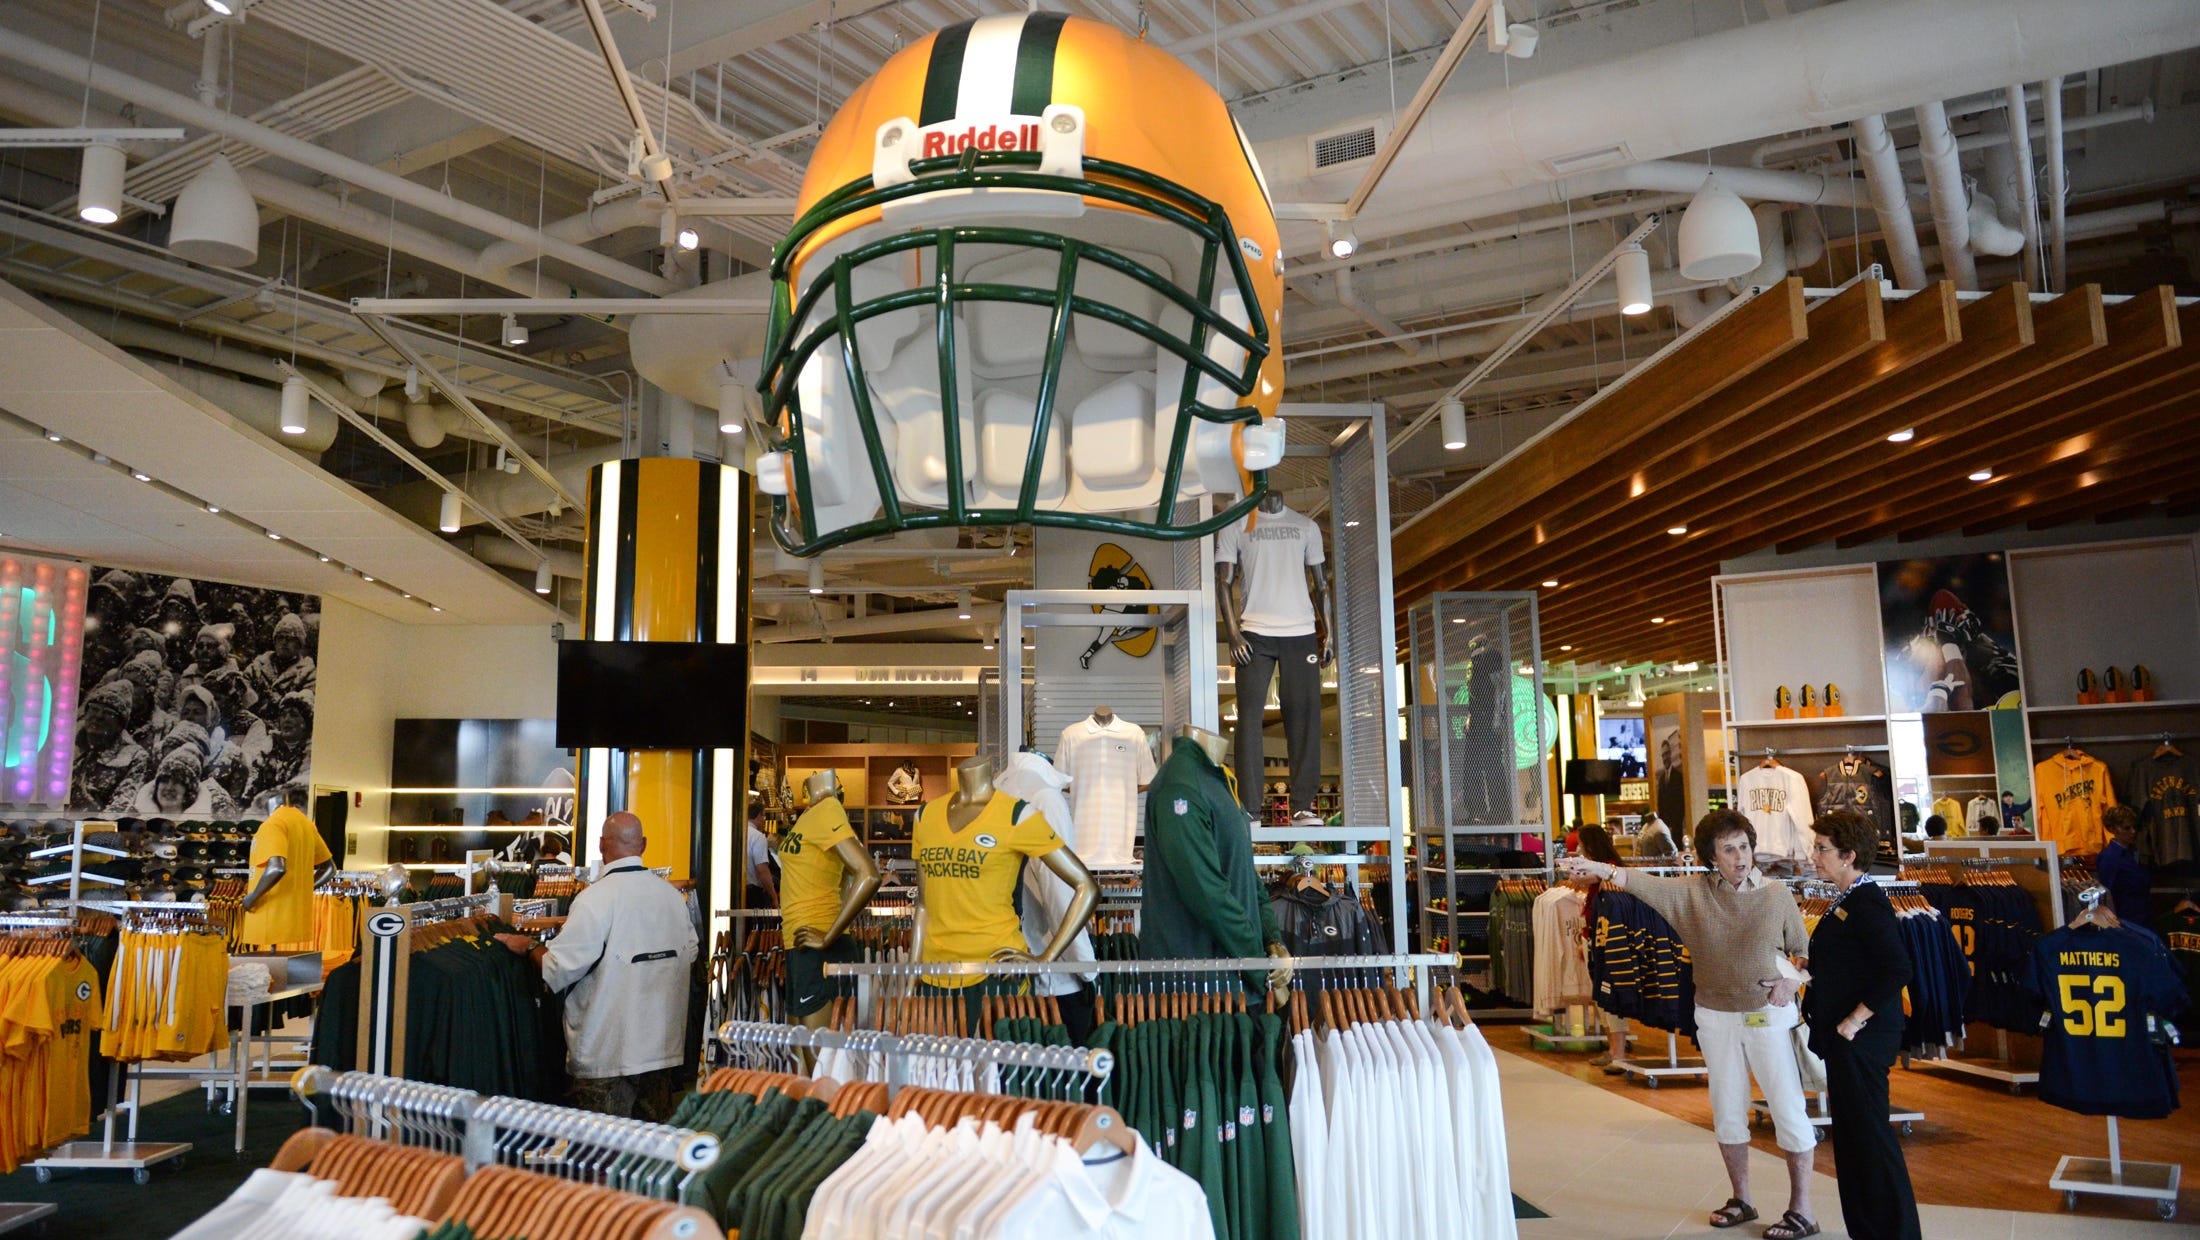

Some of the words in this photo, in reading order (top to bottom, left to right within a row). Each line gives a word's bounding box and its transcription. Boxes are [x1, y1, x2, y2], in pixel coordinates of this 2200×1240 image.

[923, 125, 1038, 157] Riddell
[1249, 526, 1301, 542] PACKERS
[855, 668, 889, 682] DON
[895, 668, 964, 682] HUTSON
[919, 847, 954, 862] REEN
[956, 848, 989, 865] BAY
[2059, 951, 2120, 967] MATTHEWS
[2057, 974, 2126, 1037] 52
